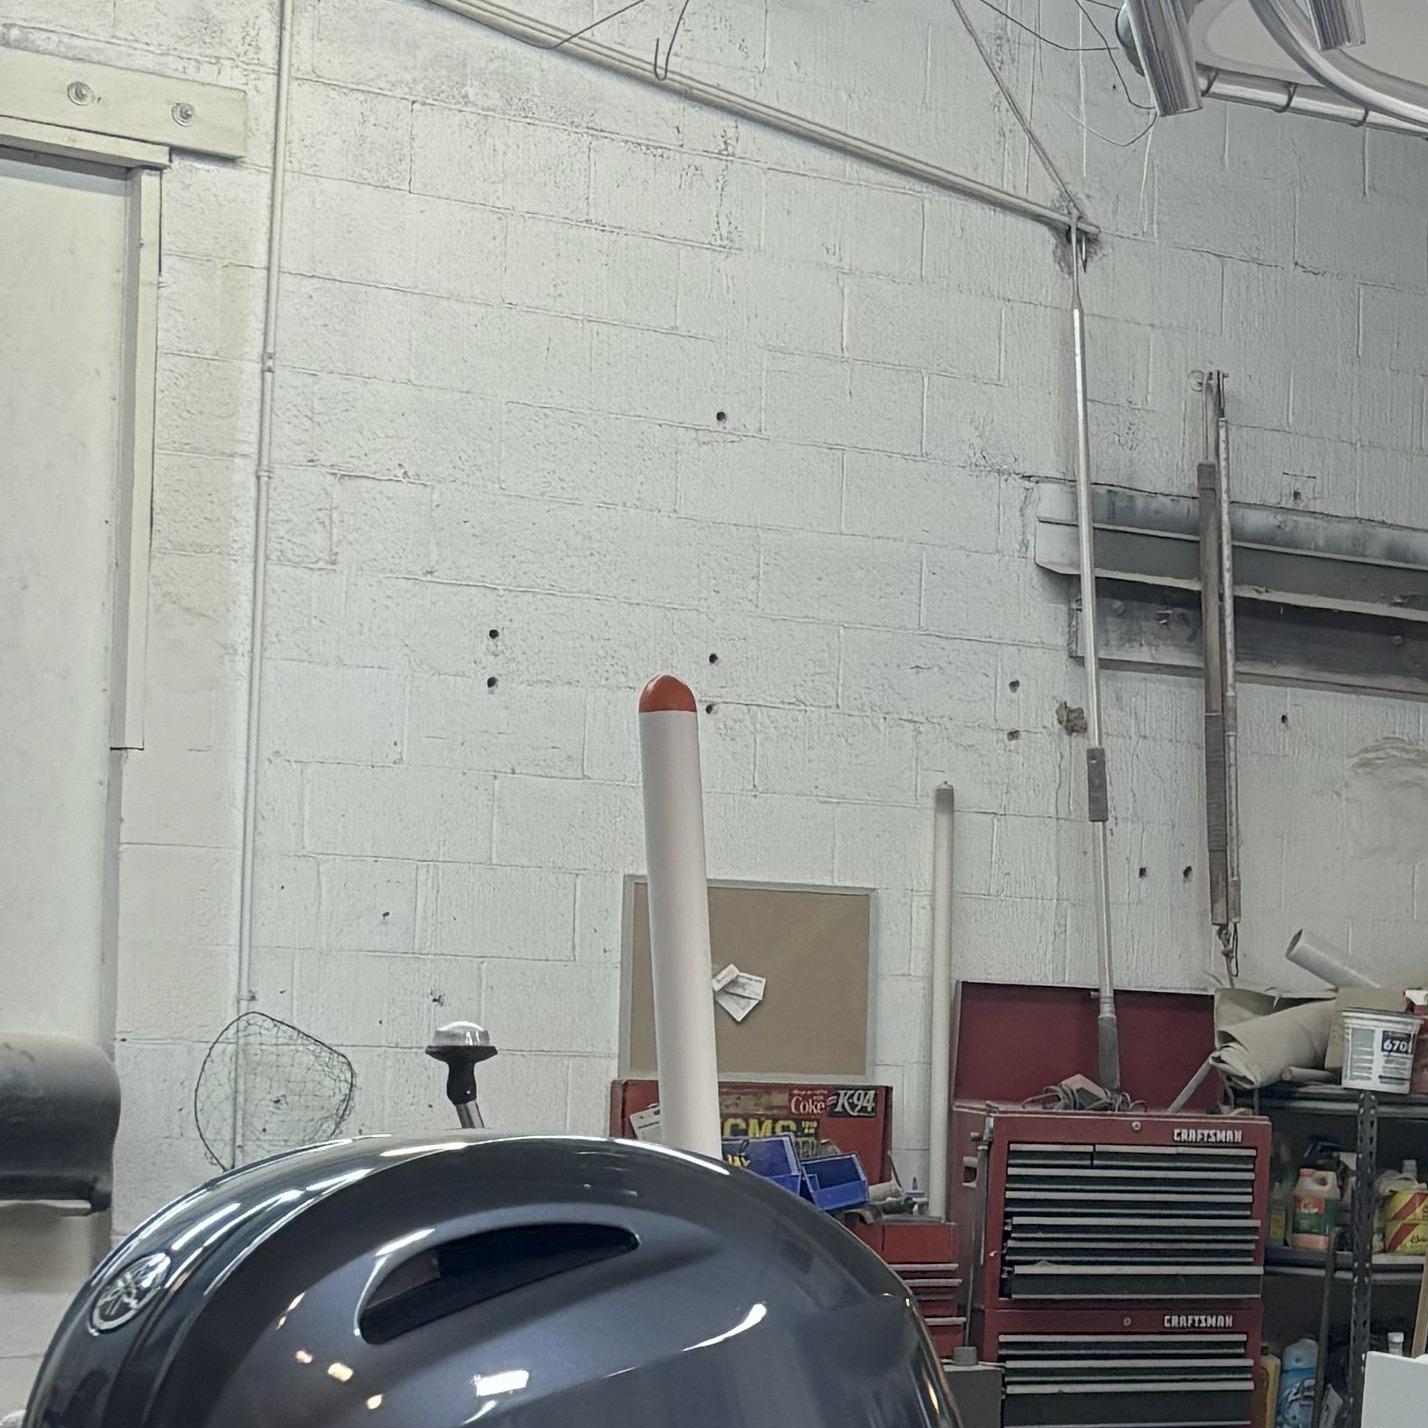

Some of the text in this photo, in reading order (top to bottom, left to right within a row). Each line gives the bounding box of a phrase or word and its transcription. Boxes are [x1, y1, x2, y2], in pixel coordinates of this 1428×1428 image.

[791, 1095, 826, 1114] Coke
[833, 1089, 876, 1117] K-94
[1173, 1128, 1243, 1143] CRAFTSMAN
[1163, 1314, 1234, 1329] CRAFTSMAN
